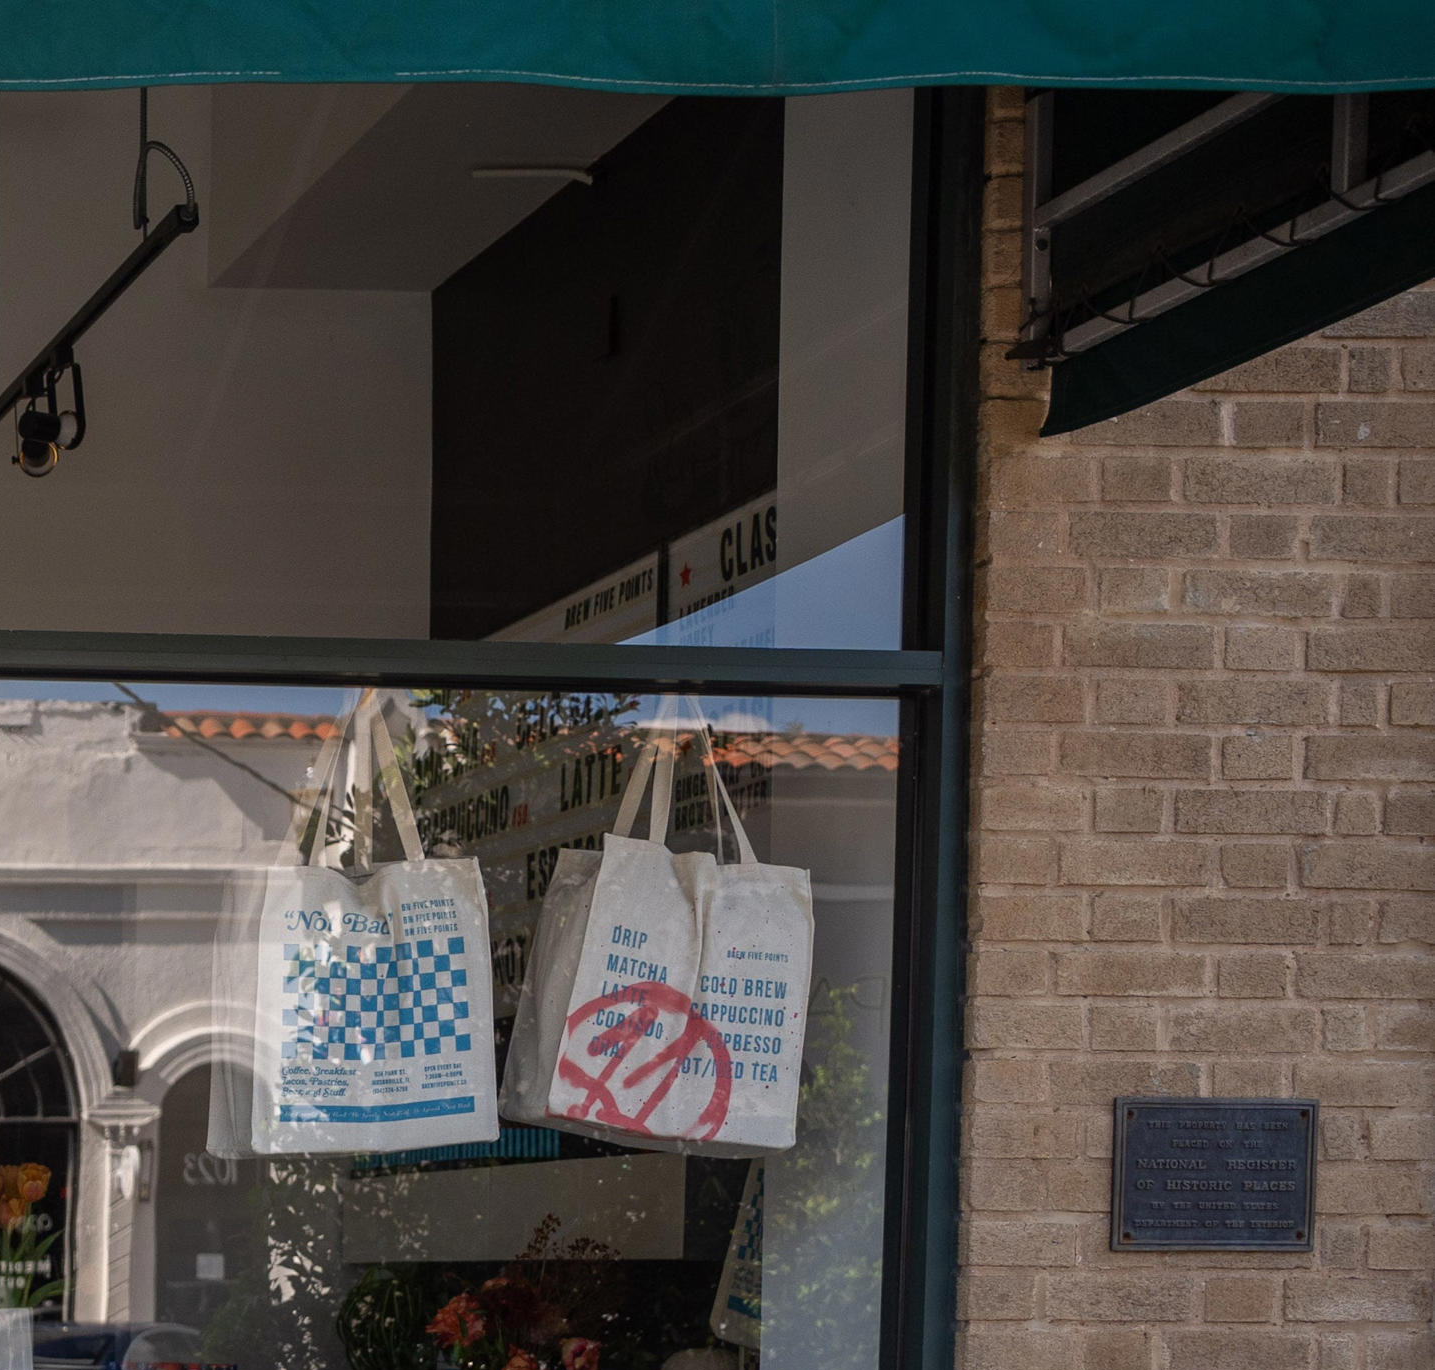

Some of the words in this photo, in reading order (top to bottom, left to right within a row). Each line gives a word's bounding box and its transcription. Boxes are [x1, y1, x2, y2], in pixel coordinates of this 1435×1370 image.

[564, 597, 591, 631] BREW
[593, 585, 615, 617] FIVE
[618, 567, 654, 605] POINTS
[560, 744, 622, 811] LATTE
[412, 900, 429, 910] FIVE
[429, 899, 455, 908] POINTS
[431, 910, 457, 920] POINTS
[433, 923, 458, 933] POINTS
[611, 925, 648, 950] DRIP
[727, 949, 745, 960] BREW
[748, 950, 763, 960] FIVE
[764, 952, 789, 963] POINTS
[606, 953, 667, 984] MATCHA
[601, 980, 648, 1006] LATTE
[700, 975, 738, 996] COLD
[744, 978, 787, 1000] BREW
[690, 1002, 785, 1027] CAPPUCCINO
[312, 1066, 357, 1076] Breakfast
[751, 1061, 778, 1082] TEA
[1148, 1121, 1171, 1130] THIS
[1178, 1121, 1227, 1130] PROPERTY
[1234, 1121, 1257, 1130] HAS
[1263, 1121, 1290, 1131] BEEN
[1171, 1139, 1210, 1149] PLACED
[1218, 1139, 1233, 1149] ON
[1243, 1140, 1262, 1149] THE
[1136, 1159, 1207, 1170] NATIONAL
[1226, 1159, 1297, 1171] REGISTER
[1136, 1180, 1154, 1191] OF
[1166, 1180, 1233, 1191] HISTORIC
[1242, 1180, 1296, 1192] PLACES
[1152, 1201, 1166, 1210] BY
[1173, 1201, 1192, 1210] THE
[1198, 1201, 1235, 1210] UNITED
[1243, 1201, 1279, 1210] STATES
[1133, 1220, 1199, 1229] DEPARTMENT
[1204, 1220, 1219, 1229] OF
[1225, 1220, 1245, 1229] THE
[1250, 1220, 1295, 1229] INTERIOR
